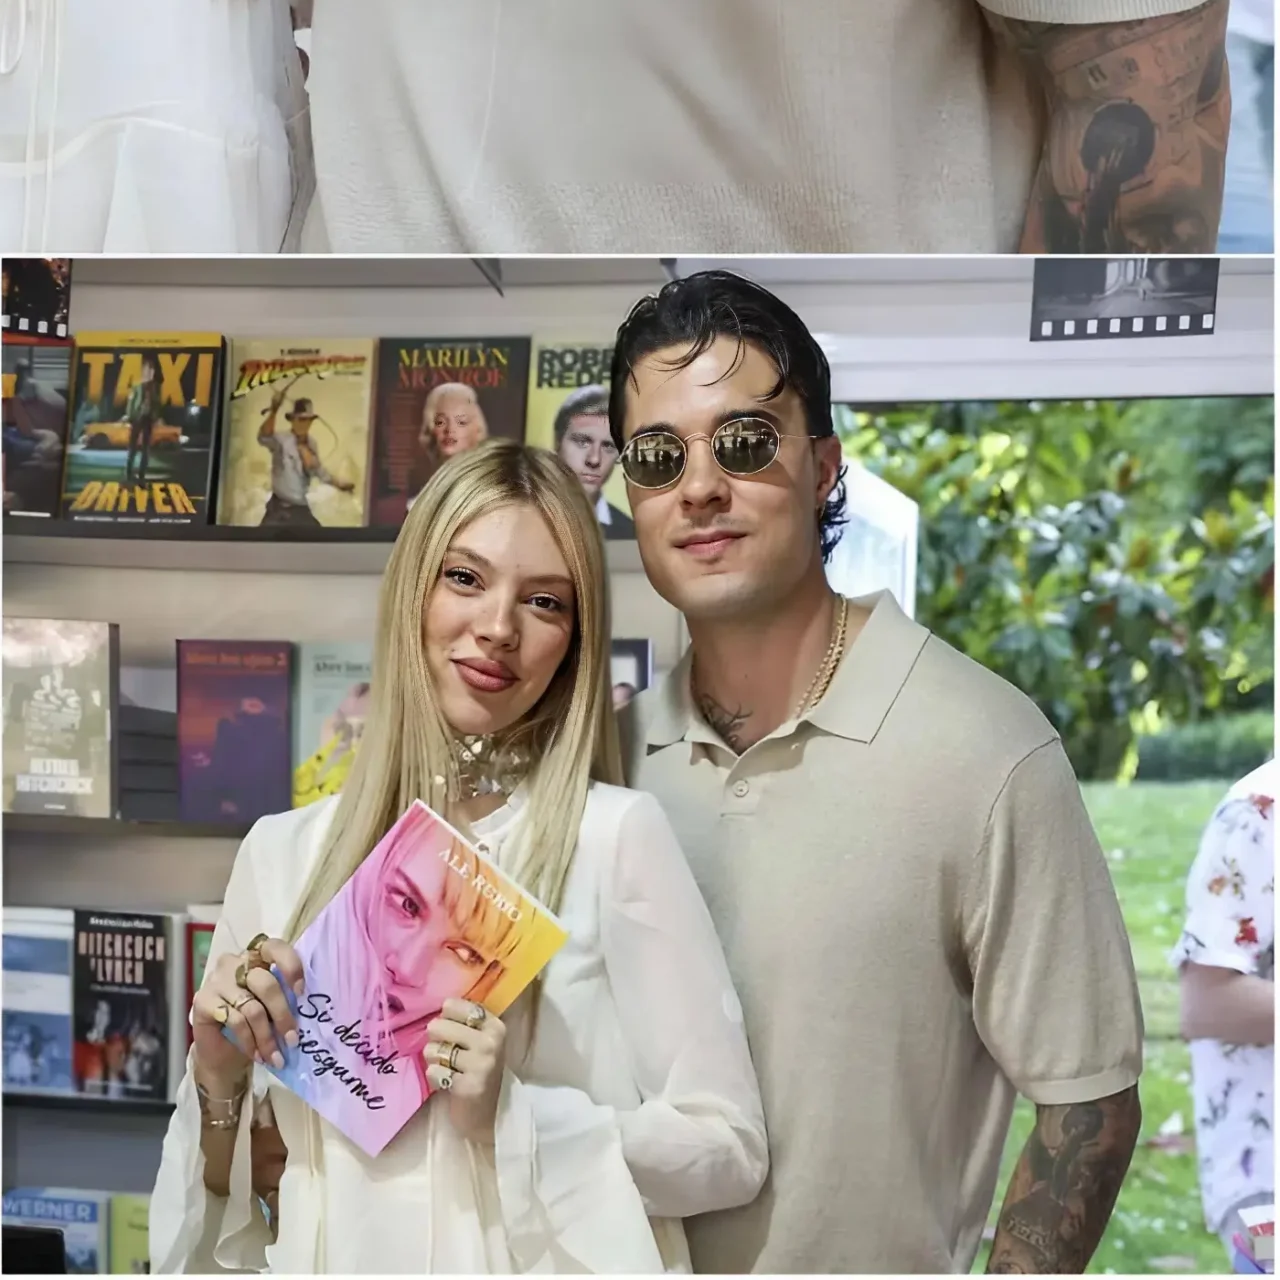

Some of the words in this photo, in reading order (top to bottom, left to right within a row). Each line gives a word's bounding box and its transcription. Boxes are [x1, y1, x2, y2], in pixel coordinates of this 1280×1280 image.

[399, 348, 509, 368] MARILYN
[81, 352, 215, 408] TAXI
[70, 480, 198, 514] DRIVER
[438, 848, 470, 879] ALE
[471, 873, 522, 922] RUBIO
[78, 931, 165, 961] HITCHCOCK
[97, 958, 144, 985] LYNCH
[297, 993, 334, 1023] Si
[333, 1019, 398, 1075] decido
[2, 1200, 91, 1221] WERNER
